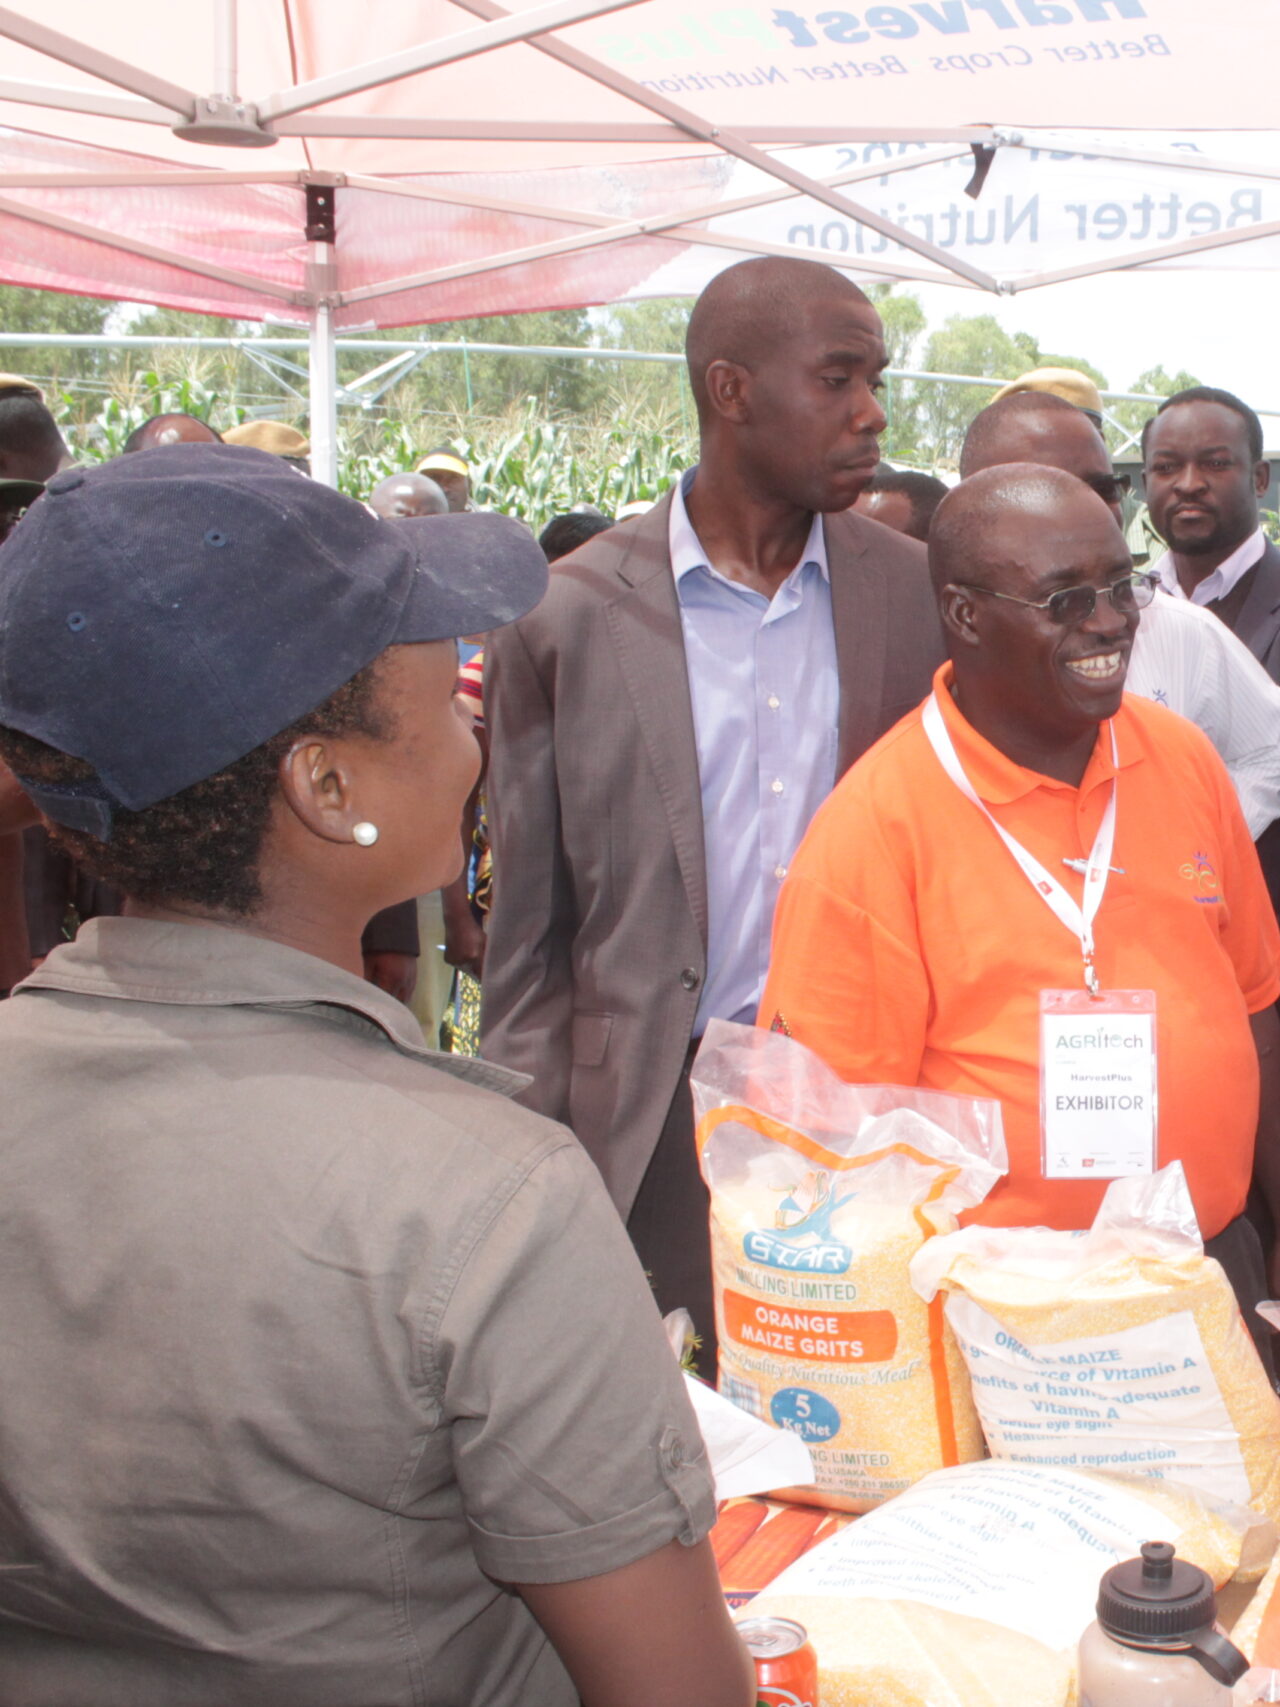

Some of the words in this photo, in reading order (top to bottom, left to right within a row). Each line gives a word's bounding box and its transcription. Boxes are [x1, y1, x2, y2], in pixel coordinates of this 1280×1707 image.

[1070, 1073, 1133, 1083] HarvestPlus
[1055, 1095, 1144, 1111] EXHIBITOR
[751, 1235, 848, 1270] STAR
[736, 1267, 787, 1296] MILLING
[790, 1281, 857, 1301] LIMITED
[755, 1306, 839, 1334] ORANGE
[741, 1323, 795, 1352] MAIZE
[799, 1338, 864, 1358] GRITS
[1058, 1349, 1123, 1365] MAIZE
[789, 1365, 867, 1386] Nutritious
[1076, 1367, 1097, 1382] of
[1101, 1362, 1177, 1381] Vitamin
[1183, 1357, 1197, 1369] A
[973, 1374, 1019, 1391] nefits
[1023, 1382, 1040, 1393] of
[794, 1394, 811, 1418] 5
[1030, 1400, 1101, 1419] Vitamin
[1105, 1407, 1121, 1420] A
[781, 1416, 802, 1436] Kg
[804, 1421, 831, 1437] Net
[1045, 1420, 1071, 1432] eye
[832, 1453, 890, 1466] LIMITED
[1009, 1452, 1077, 1465] Enhanced
[1081, 1448, 1177, 1467] reproduction
[828, 1466, 867, 1477] LUSAKA
[1046, 1505, 1117, 1556] adequat
